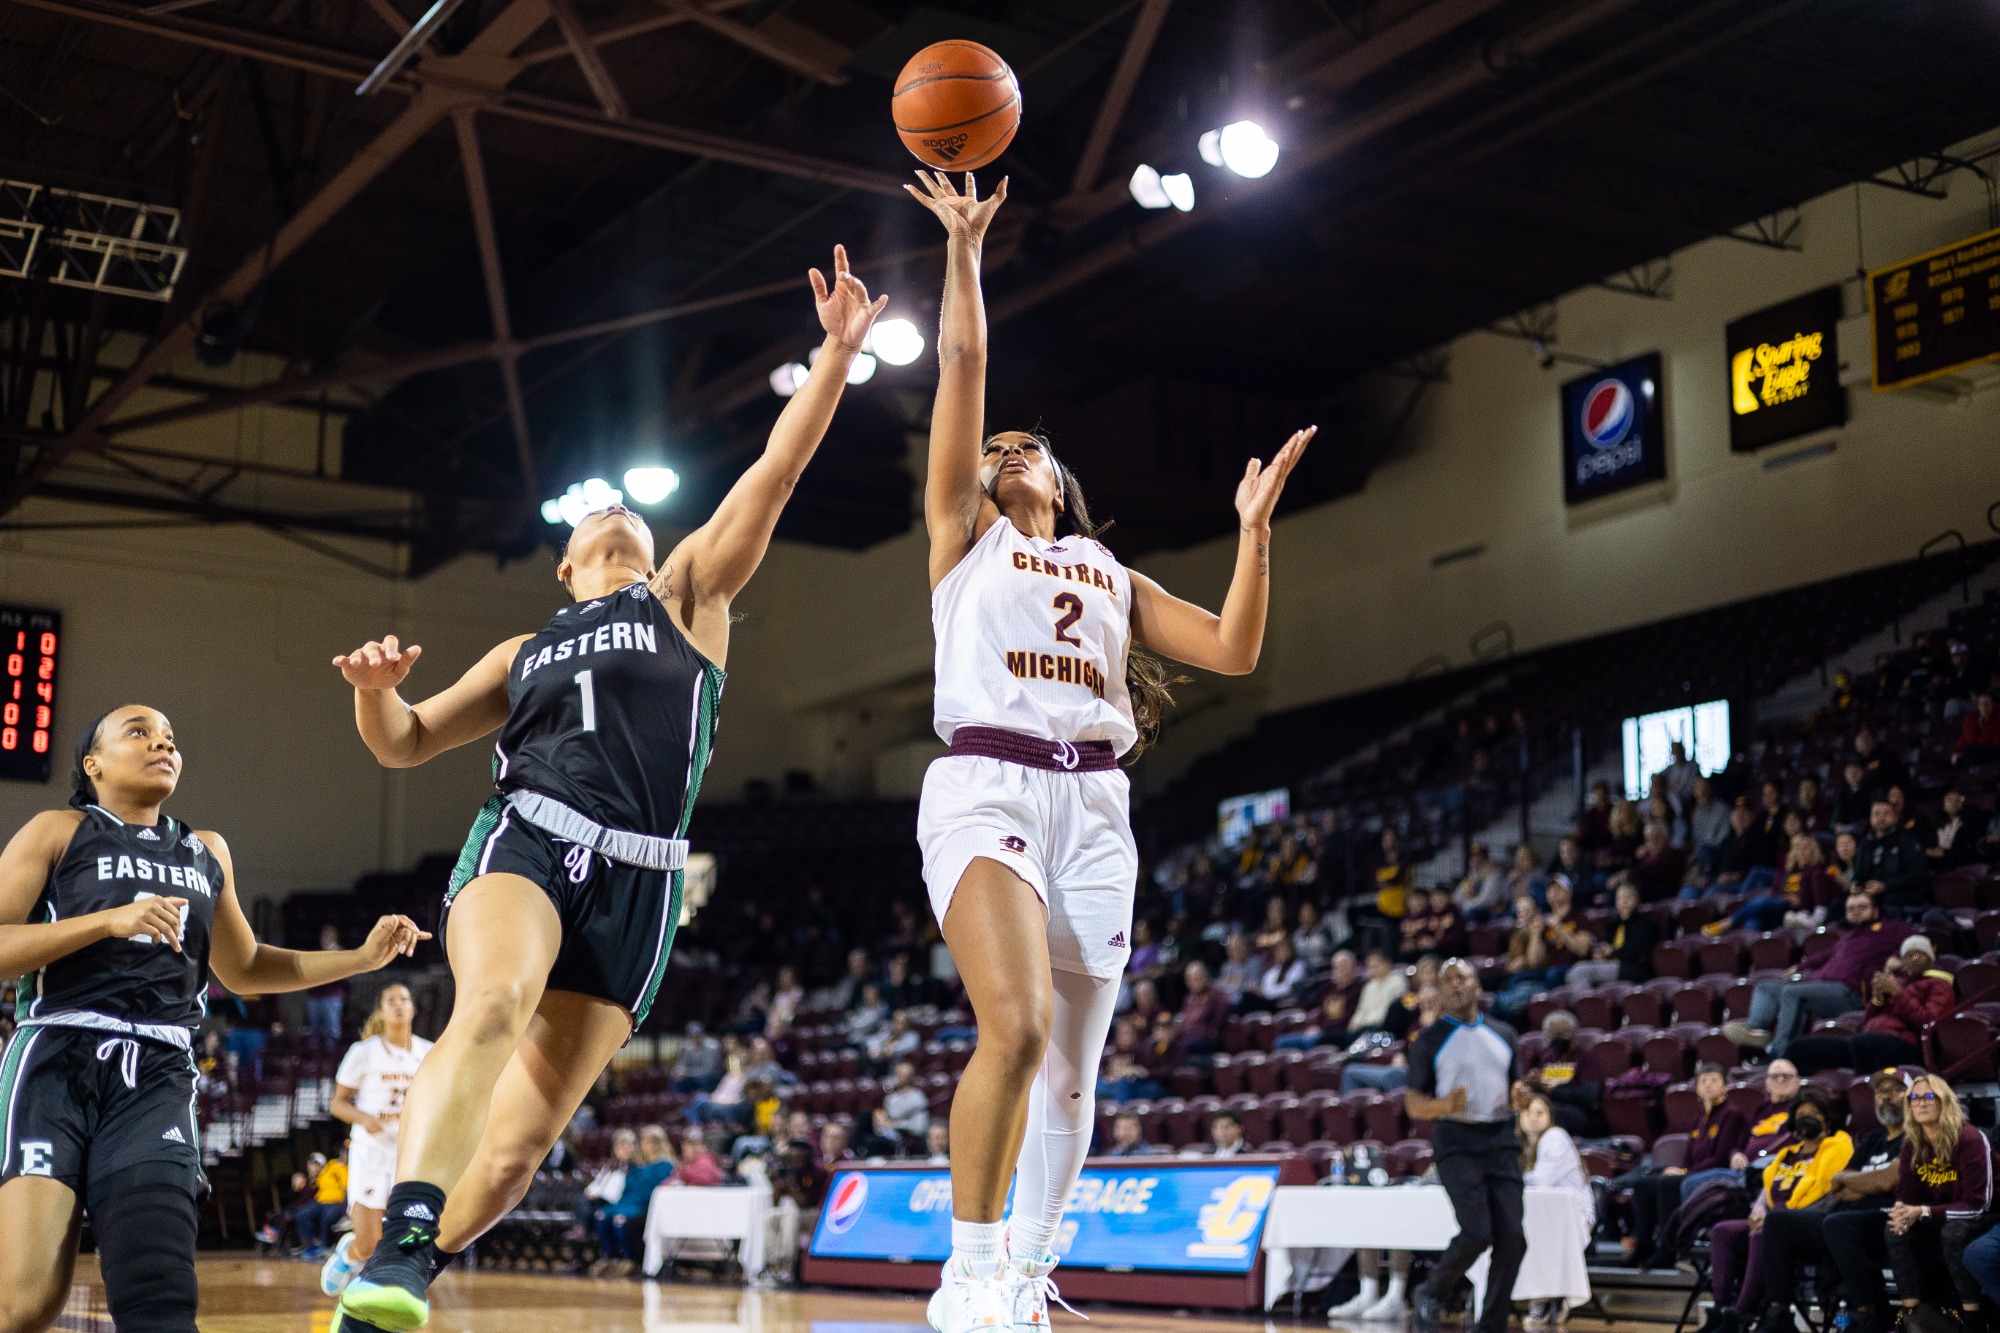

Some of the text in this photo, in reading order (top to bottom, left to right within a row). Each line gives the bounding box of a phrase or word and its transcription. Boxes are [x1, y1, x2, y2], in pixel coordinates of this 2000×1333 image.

[922, 132, 968, 148] adidas
[1577, 434, 1642, 486] pepsi
[1012, 551, 1118, 597] CENTRAL
[1053, 591, 1084, 649] 2
[40, 632, 56, 655] 0
[520, 622, 657, 682] EASTERN
[8, 653, 23, 676] 0
[4, 703, 19, 725] 0
[573, 669, 596, 732] 1
[2, 727, 17, 750] 0
[97, 855, 212, 899] EASTERN
[20, 1142, 53, 1176] E
[1064, 1177, 1159, 1214] ERAGE
[404, 1207, 434, 1221] adidas
